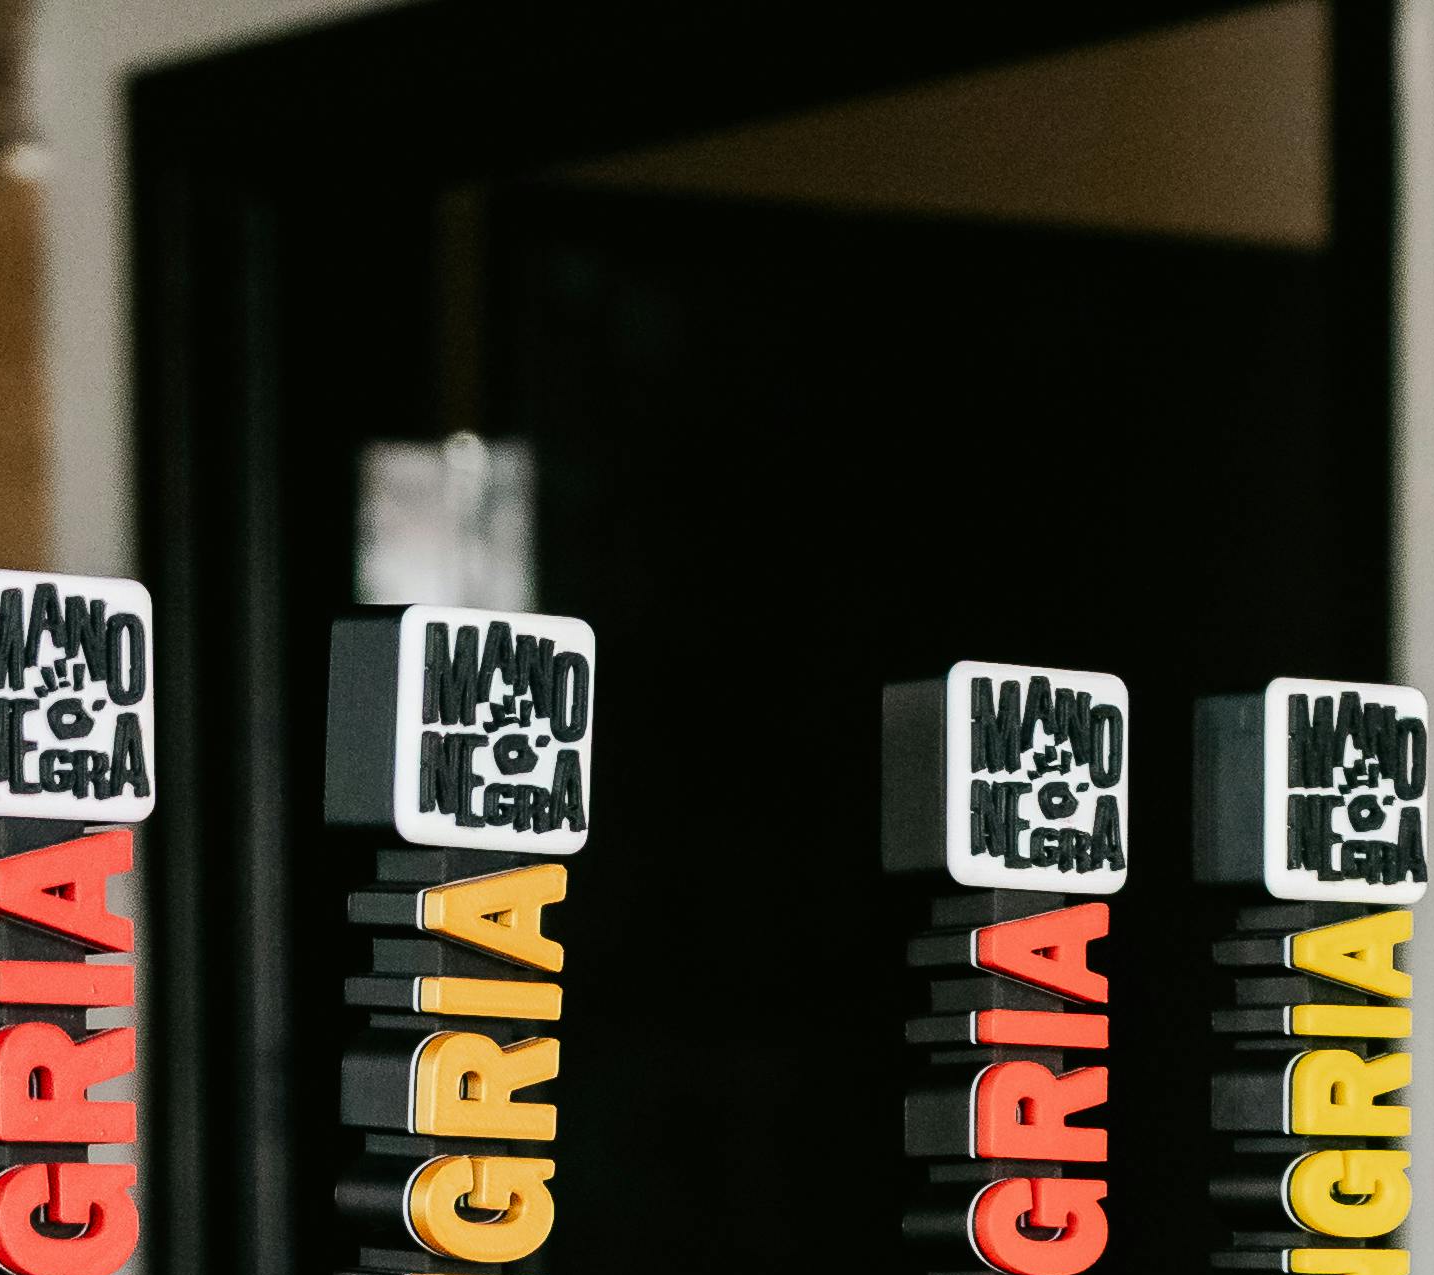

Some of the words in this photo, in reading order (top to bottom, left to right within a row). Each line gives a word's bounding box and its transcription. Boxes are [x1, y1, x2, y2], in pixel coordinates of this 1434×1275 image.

[420, 620, 590, 743] MANO
[969, 676, 1124, 788] MANO
[418, 730, 588, 834] NEGRA
[1286, 691, 1427, 801] MANO
[969, 779, 1126, 874] NEGRA
[1286, 794, 1428, 885] NEGRA
